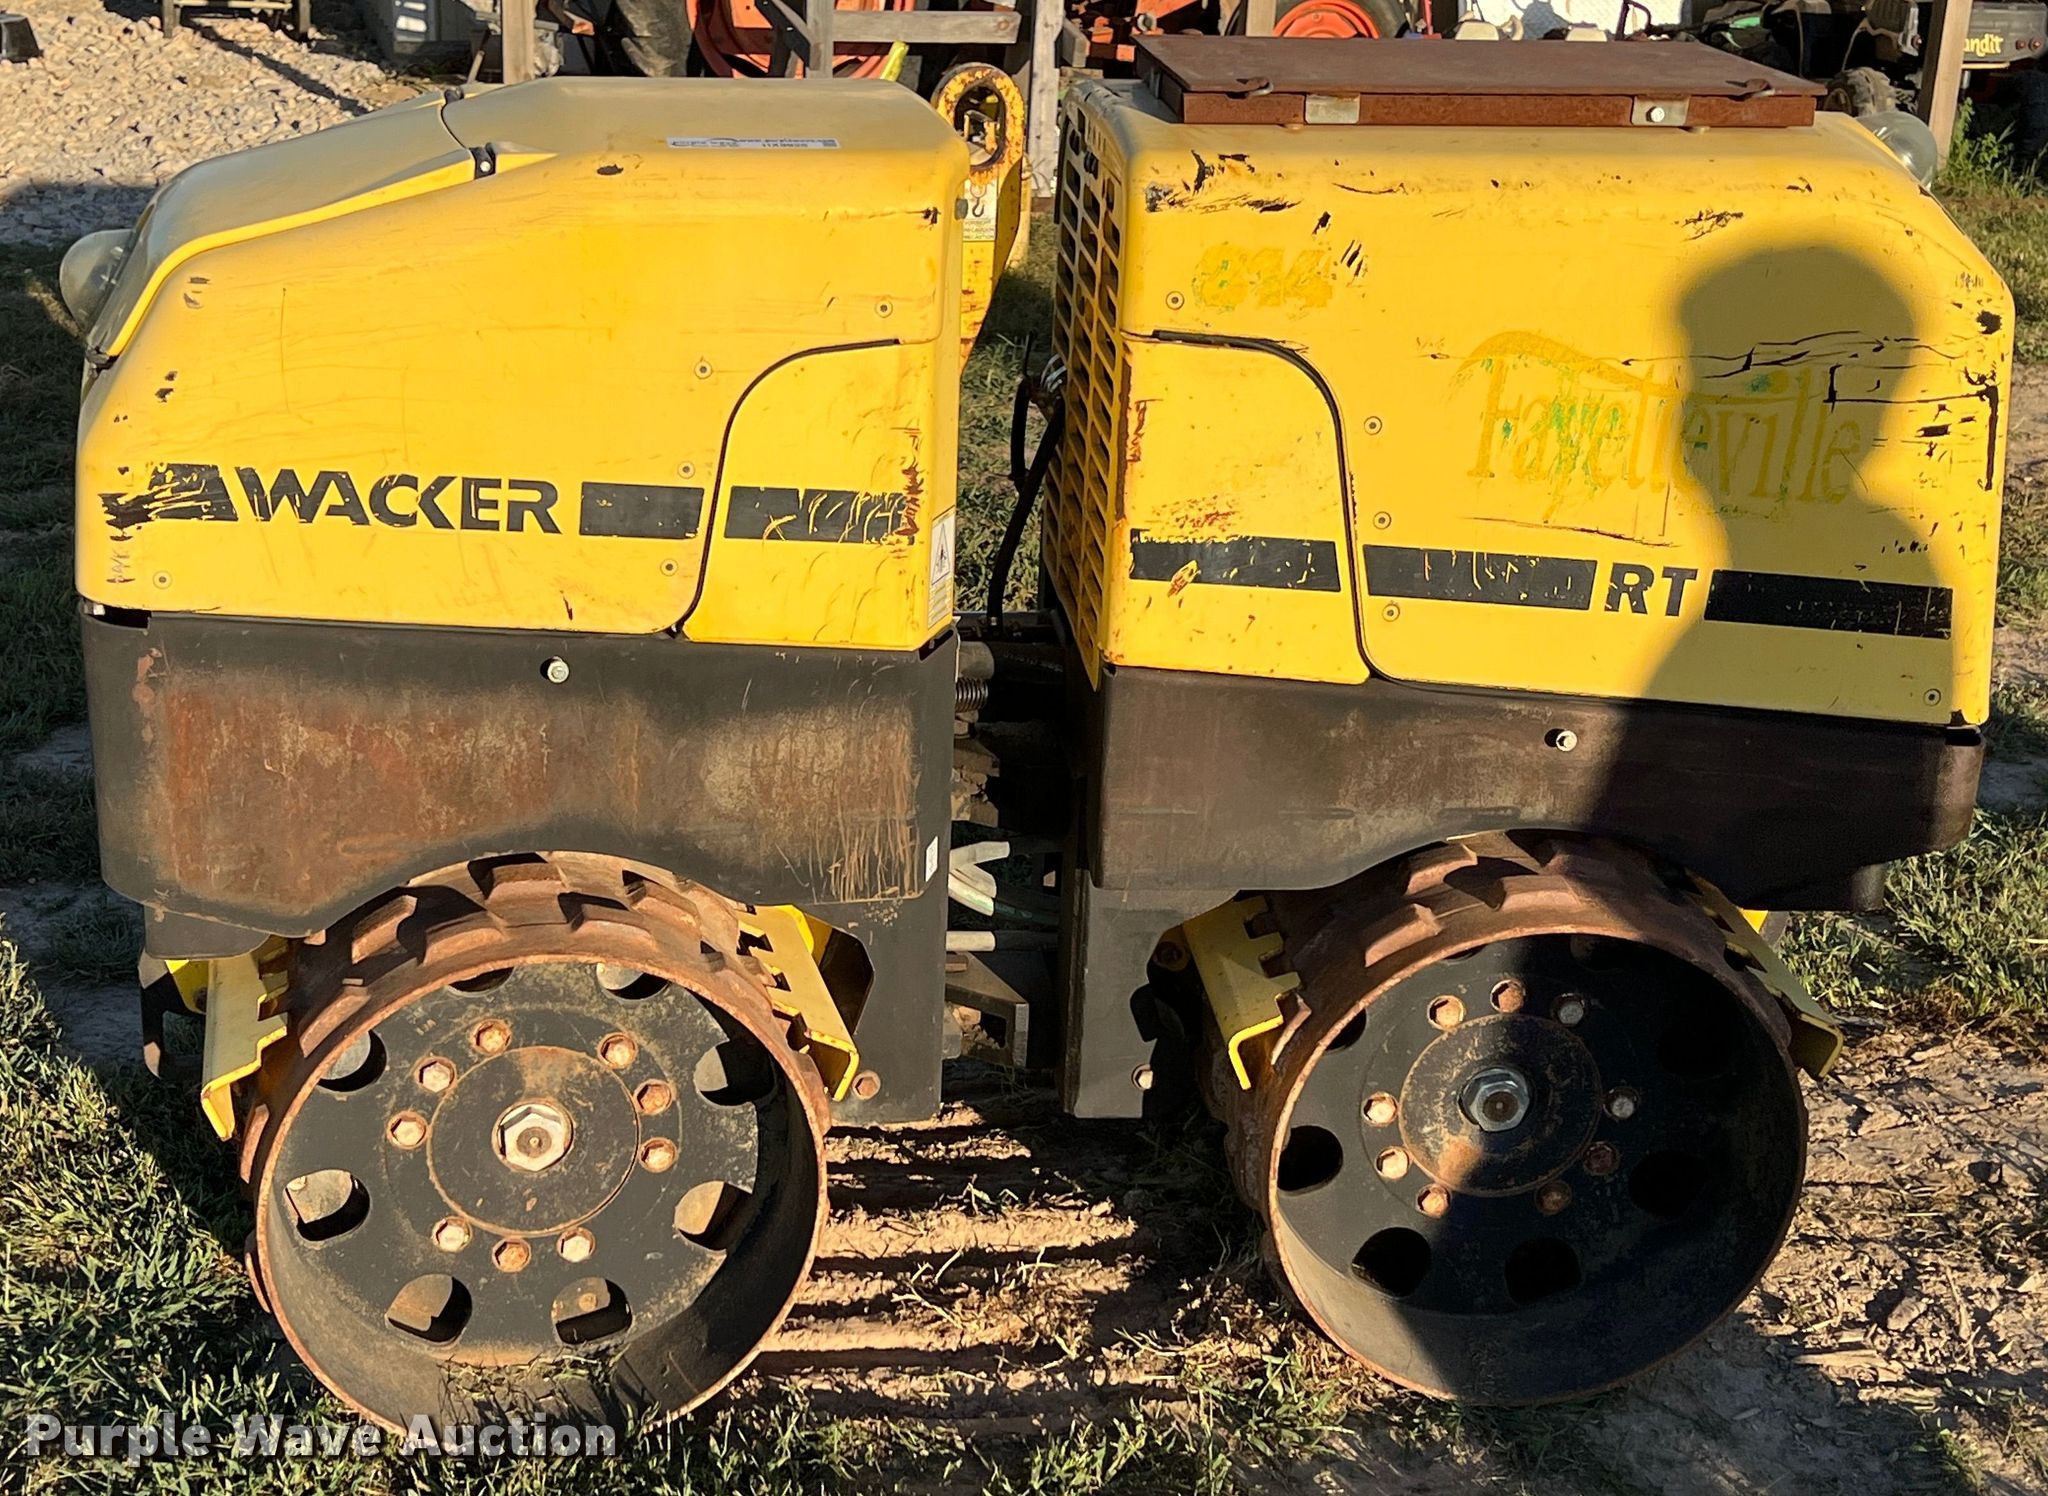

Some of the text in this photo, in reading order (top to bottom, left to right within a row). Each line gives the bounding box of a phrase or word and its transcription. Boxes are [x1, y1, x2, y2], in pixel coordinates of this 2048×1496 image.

[1963, 33, 2004, 57] andit
[1450, 331, 1862, 523] Fayetteville
[234, 466, 562, 535] WACKER
[1603, 562, 1699, 617] RT
